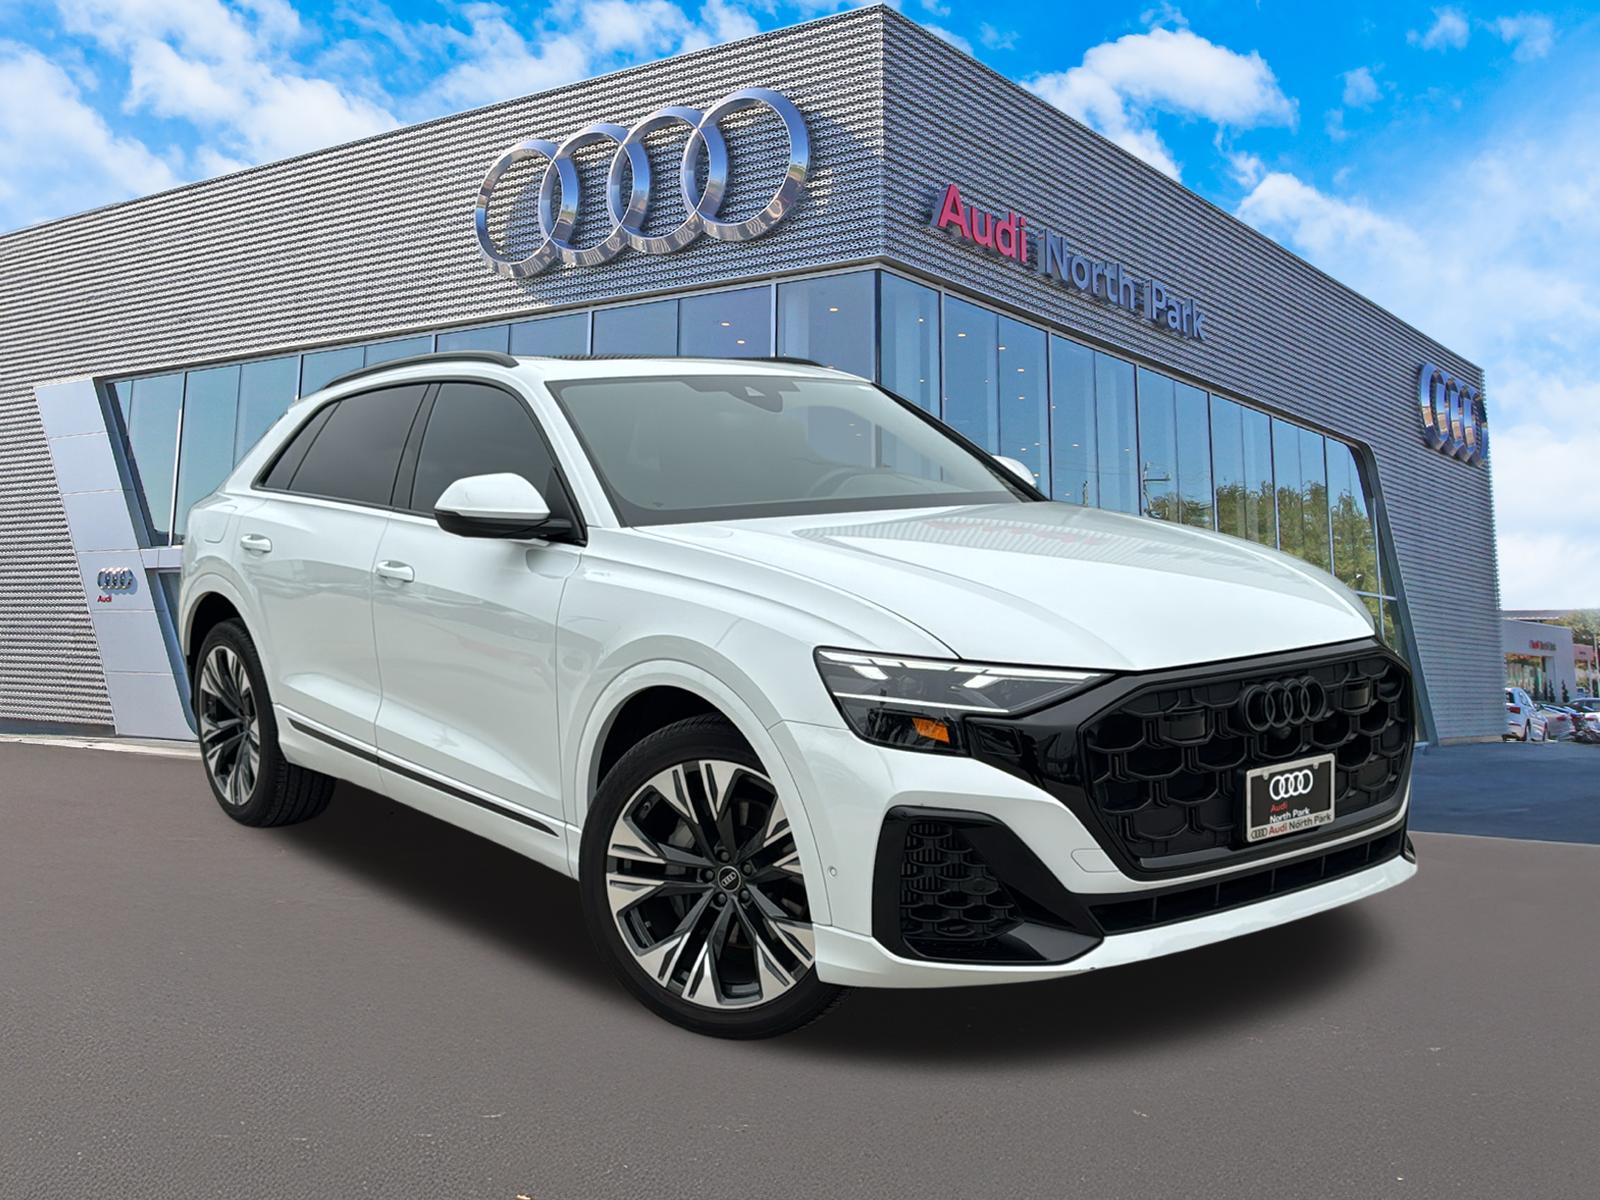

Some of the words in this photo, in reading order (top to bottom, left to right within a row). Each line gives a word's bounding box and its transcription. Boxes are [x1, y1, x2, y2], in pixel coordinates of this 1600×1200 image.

[934, 183, 1028, 264] Audi
[1039, 229, 1136, 310] North
[1144, 278, 1206, 341] Park
[1270, 812, 1291, 823] North
[1293, 807, 1310, 817] Park
[1271, 802, 1288, 812] Audi
[1269, 824, 1288, 835] Audi
[1289, 819, 1313, 830] North
[1314, 814, 1331, 823] Park
